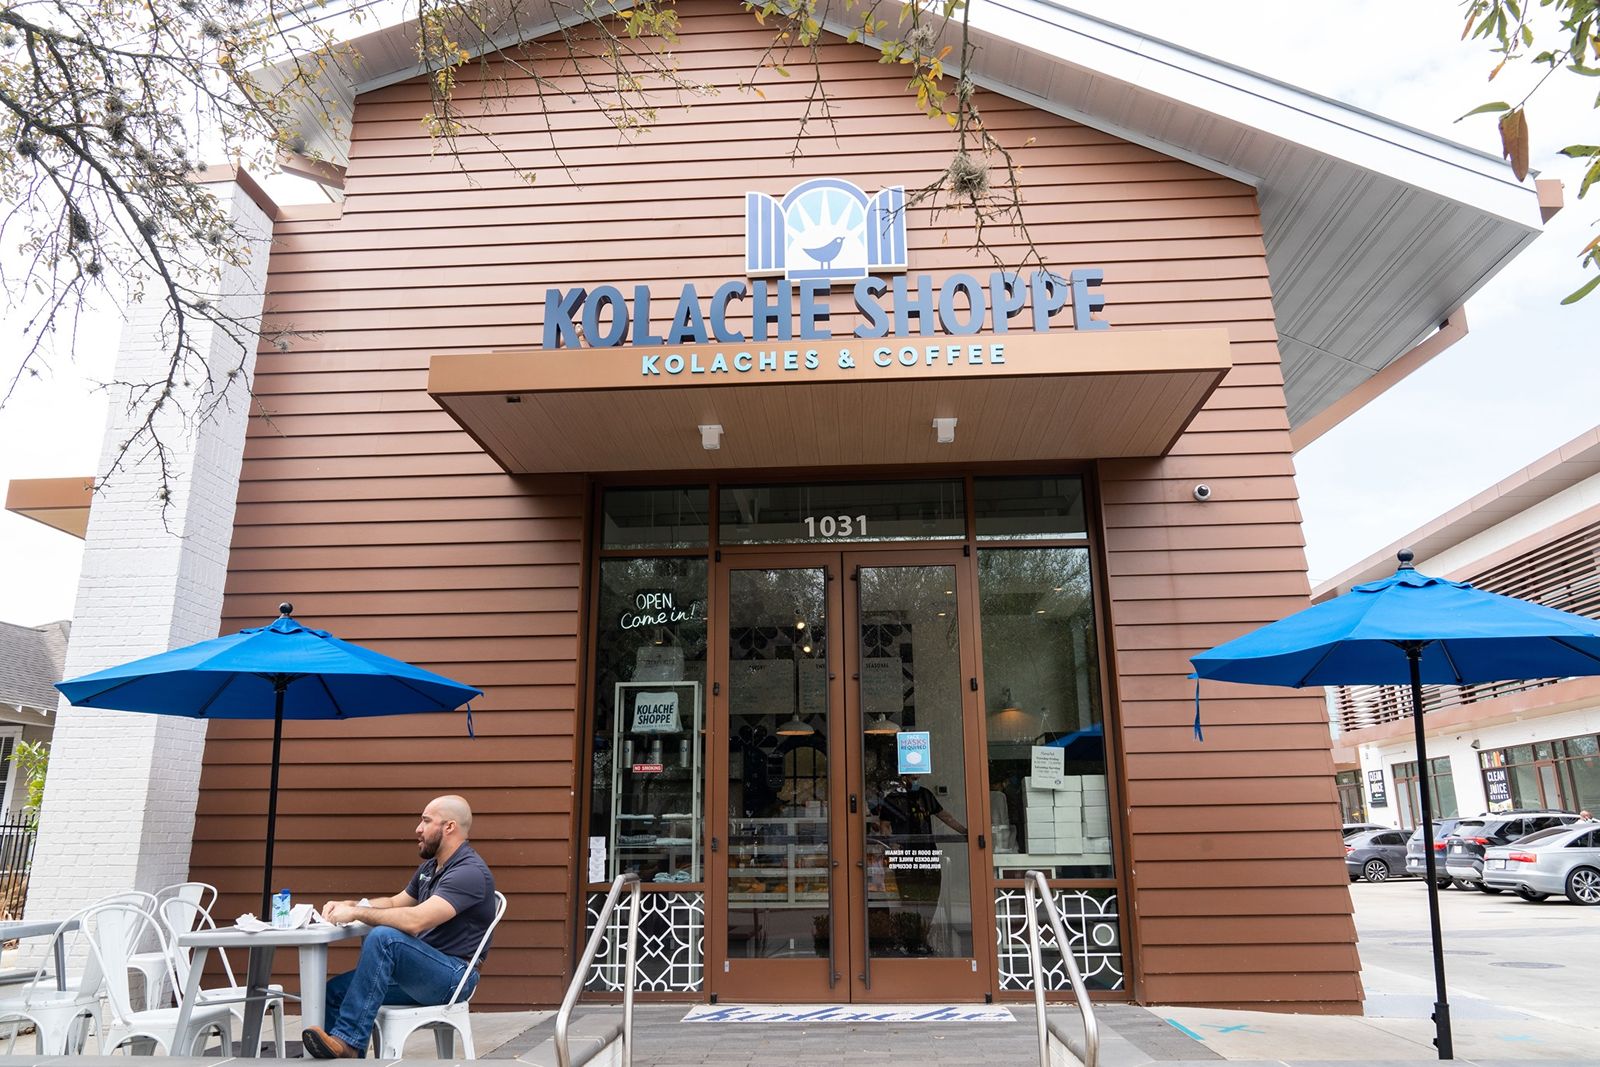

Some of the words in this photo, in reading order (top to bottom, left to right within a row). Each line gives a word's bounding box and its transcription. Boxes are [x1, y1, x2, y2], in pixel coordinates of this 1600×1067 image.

[542, 279, 832, 350] KOLACHE
[853, 269, 1111, 339] SHOPPE
[641, 350, 820, 375] KOLACHES
[838, 349, 855, 369] &
[873, 344, 1006, 367] COFFEE
[804, 514, 867, 537] 1031
[636, 593, 672, 610] OPEN
[620, 612, 668, 630] Come
[670, 602, 696, 622] in!
[637, 714, 671, 725] SHOPPE
[1486, 770, 1506, 782] CLEAN
[1489, 783, 1508, 795] JUICE
